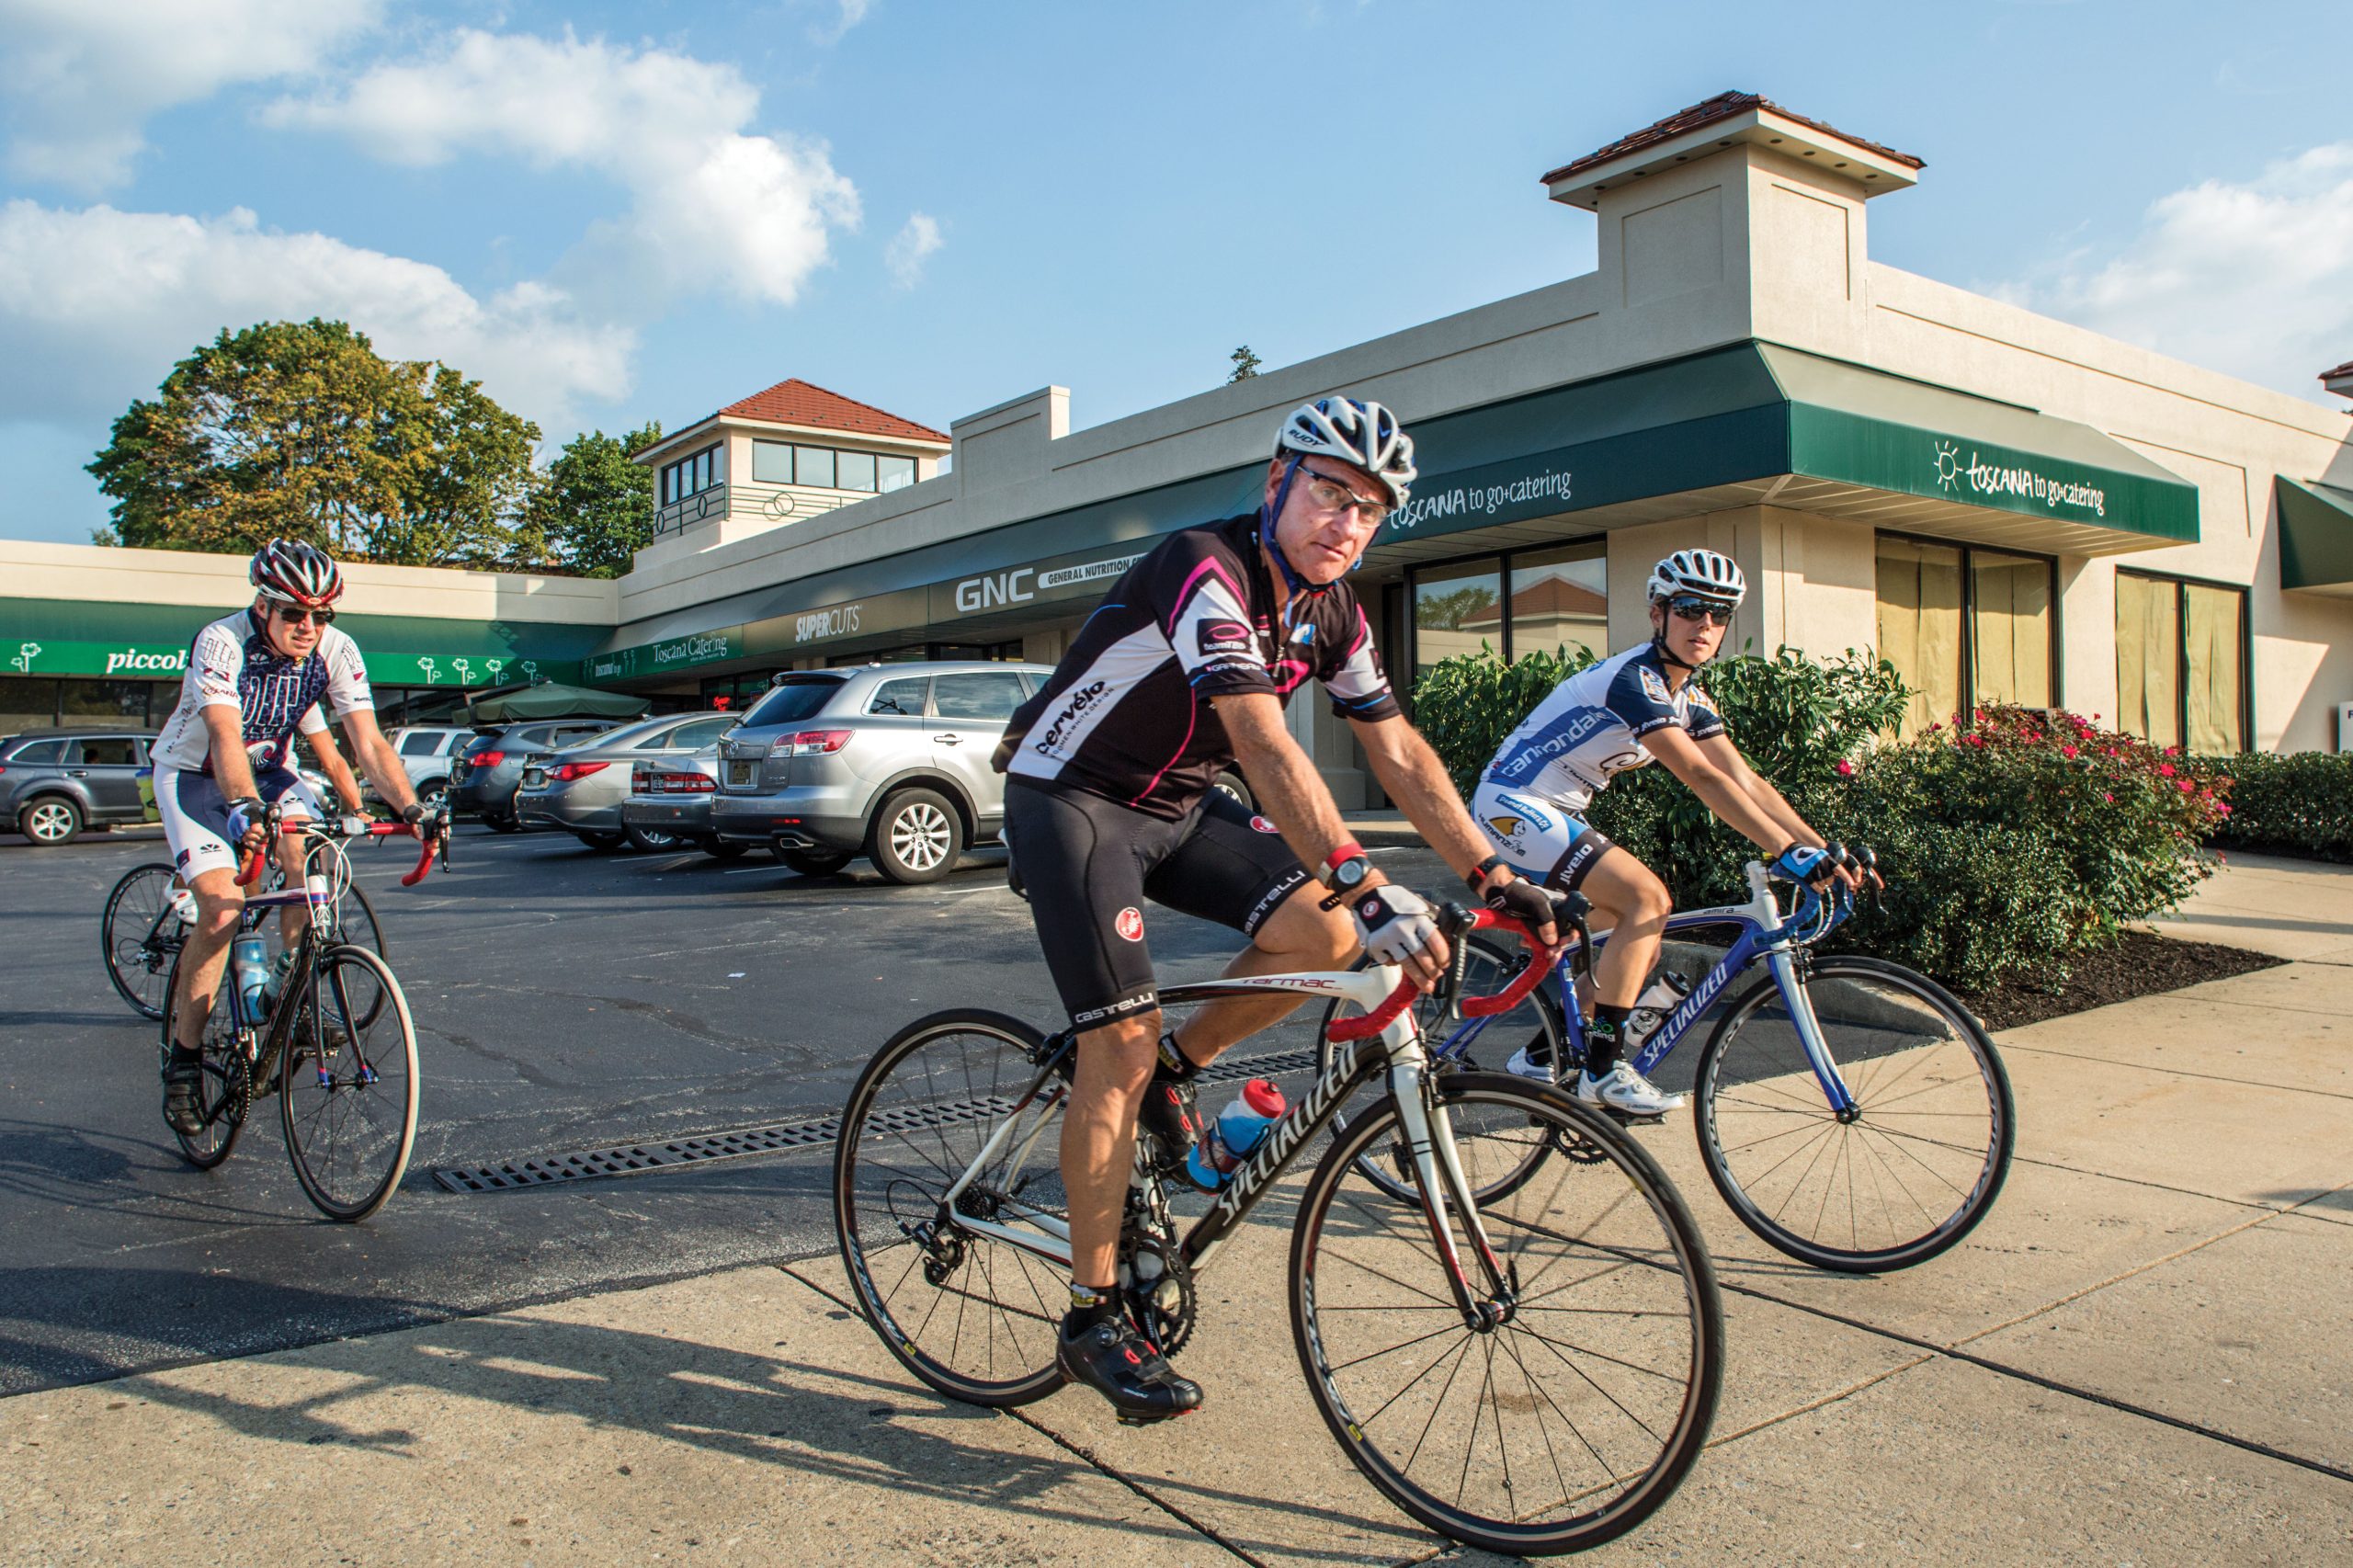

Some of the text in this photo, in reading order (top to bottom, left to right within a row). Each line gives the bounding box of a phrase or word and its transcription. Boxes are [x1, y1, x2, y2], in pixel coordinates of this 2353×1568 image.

[1469, 487, 1484, 510] to
[2034, 473, 2047, 499] to
[956, 568, 1033, 612] GNC
[1048, 566, 1083, 585] GENERAL
[1085, 558, 1130, 578] NUTRITION
[795, 604, 860, 642] SUPERCUTS
[106, 648, 189, 674] piccol
[653, 635, 727, 663] Toscana Catering
[1035, 680, 1107, 755] cervélo
[1643, 961, 1729, 1067] SPECIALIZED
[1218, 1040, 1358, 1227] SPECIALIZED
